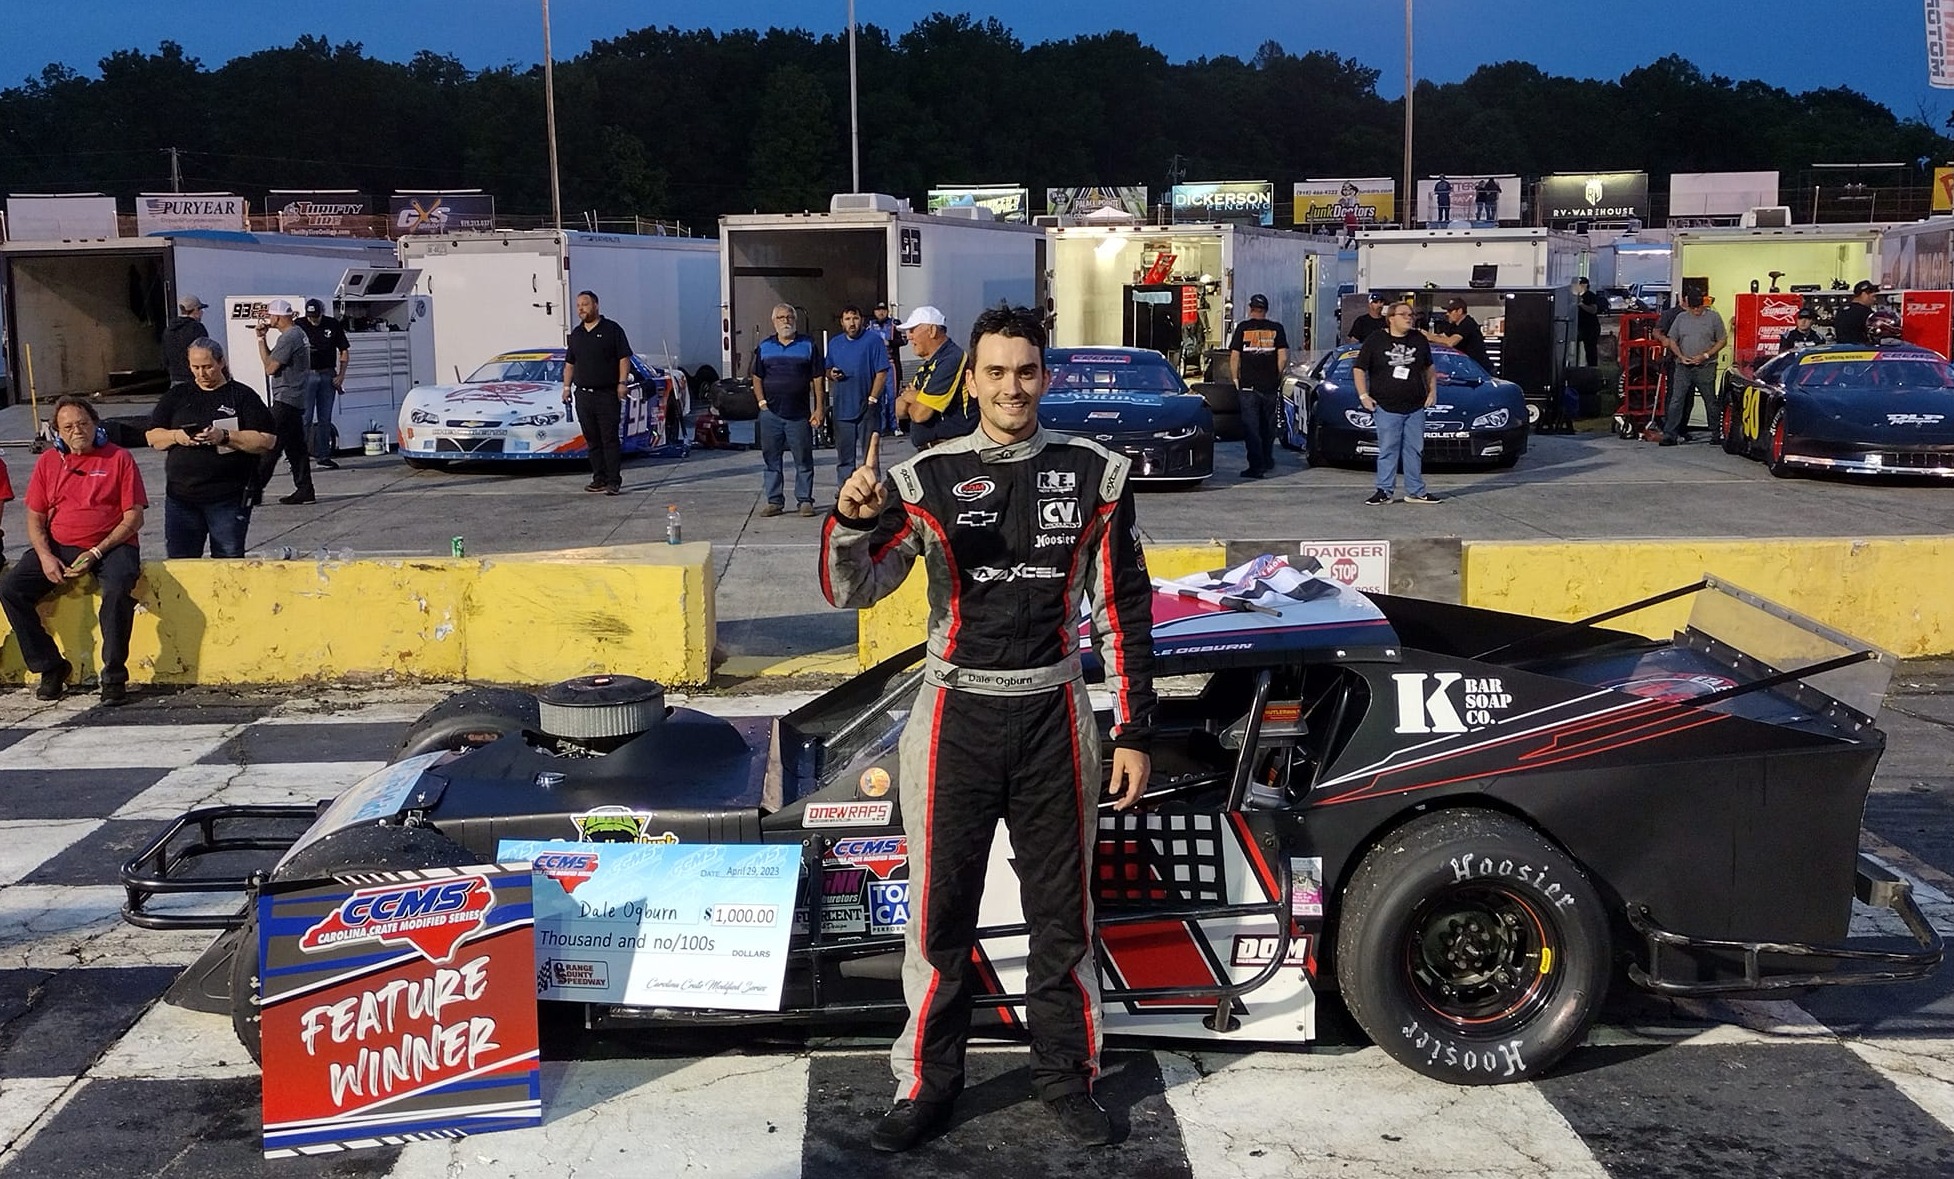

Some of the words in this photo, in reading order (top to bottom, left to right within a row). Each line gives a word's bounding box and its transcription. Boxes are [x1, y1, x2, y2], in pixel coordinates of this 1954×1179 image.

[1175, 192, 1271, 206] DICKERSON
[163, 201, 235, 215] PURYEAR
[1043, 502, 1075, 522] CV
[1035, 533, 1076, 548] Hoosier
[1306, 546, 1384, 558] DANGER
[1331, 563, 1357, 581] STOP
[1176, 643, 1252, 654] OGBURN
[968, 674, 991, 684] Dale
[995, 676, 1033, 688] Ogburn
[1464, 679, 1503, 693] BAR
[1391, 672, 1468, 733] K
[1465, 693, 1513, 709] SOAP
[1466, 710, 1496, 725] CO.
[833, 840, 901, 856] CCMS
[534, 855, 588, 869] CCMS
[700, 869, 719, 877] DATE
[726, 867, 745, 877] April
[747, 867, 758, 877] 29,
[760, 867, 780, 876] 2023
[1450, 853, 1576, 909] Hoosier
[343, 878, 473, 926] CCMS
[578, 900, 616, 918] Dale
[623, 901, 678, 926] Ogburn
[703, 907, 713, 921] $
[716, 908, 775, 925] 1,000.00
[317, 928, 368, 944] CAROLINA
[369, 922, 398, 935] CRATE
[399, 915, 446, 931] MODIFIED
[448, 909, 481, 924] SERIES
[540, 930, 613, 948] Thousand
[618, 933, 647, 949] and
[653, 933, 716, 952] no/100s
[731, 950, 771, 958] DOLLARS
[301, 956, 491, 1056] FEATURE
[1402, 1021, 1527, 1077] Hoosier
[329, 1016, 501, 1107] WINNER
